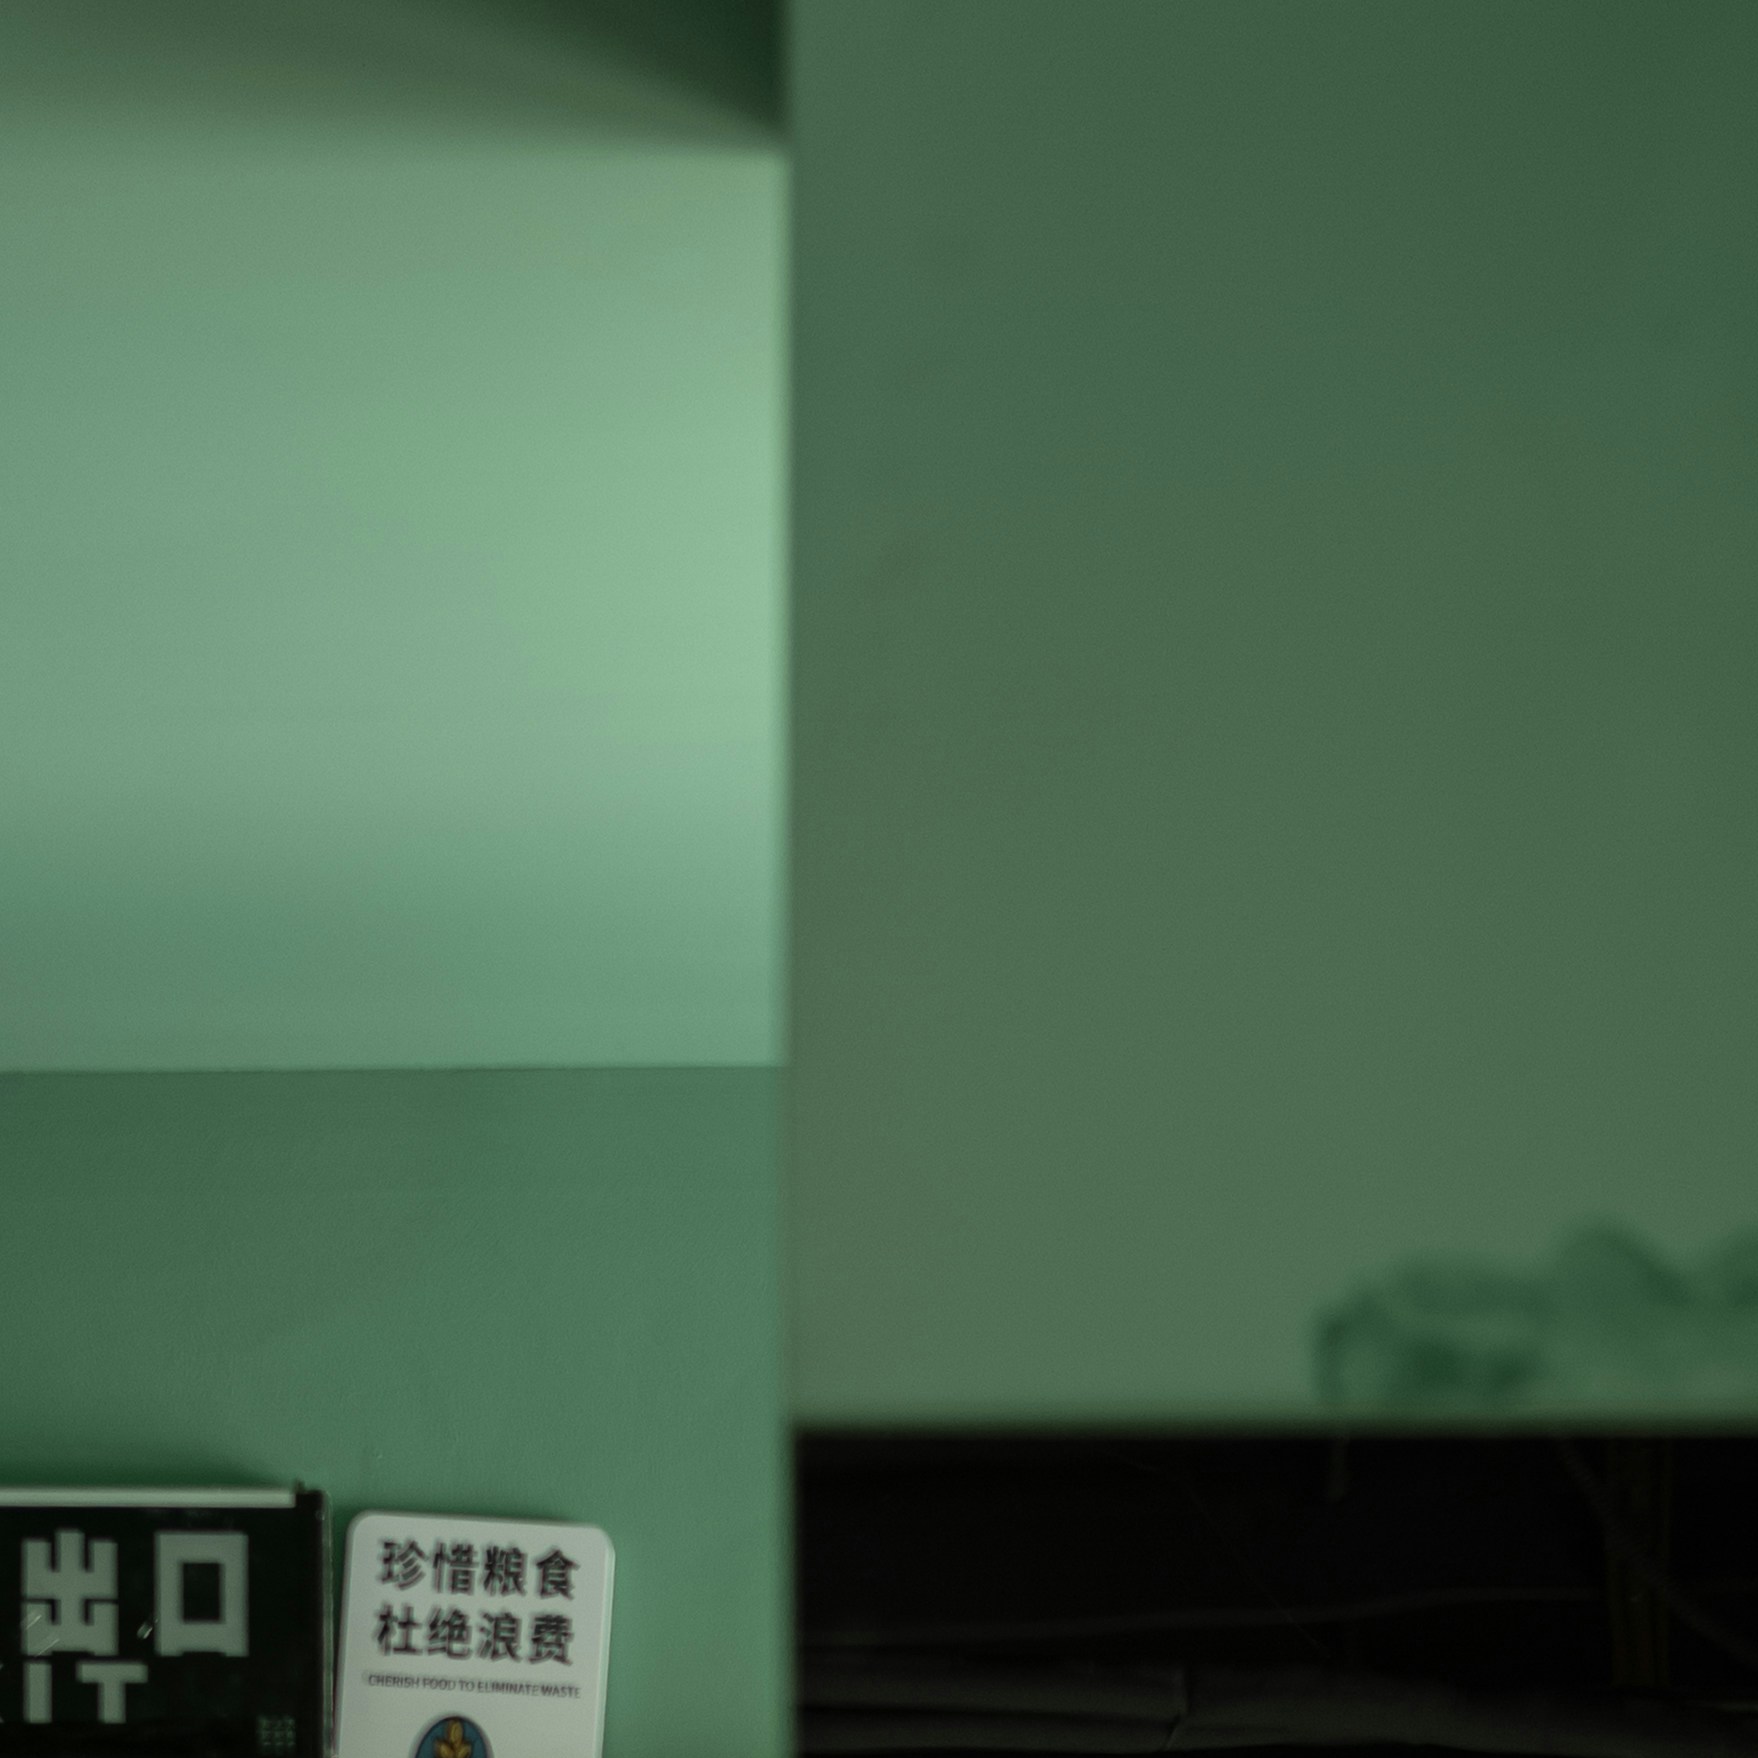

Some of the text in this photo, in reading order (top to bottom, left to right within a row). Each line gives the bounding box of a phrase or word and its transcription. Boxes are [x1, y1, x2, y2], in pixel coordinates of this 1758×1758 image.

[22, 1528, 249, 1656] 出口
[378, 1537, 580, 1600] 珍惜粮食
[374, 1602, 575, 1666] 杜绝浪费
[0, 1661, 148, 1723] IT
[368, 1673, 582, 1699] CHERISH FOOD TO ELIMINATE WASTE
